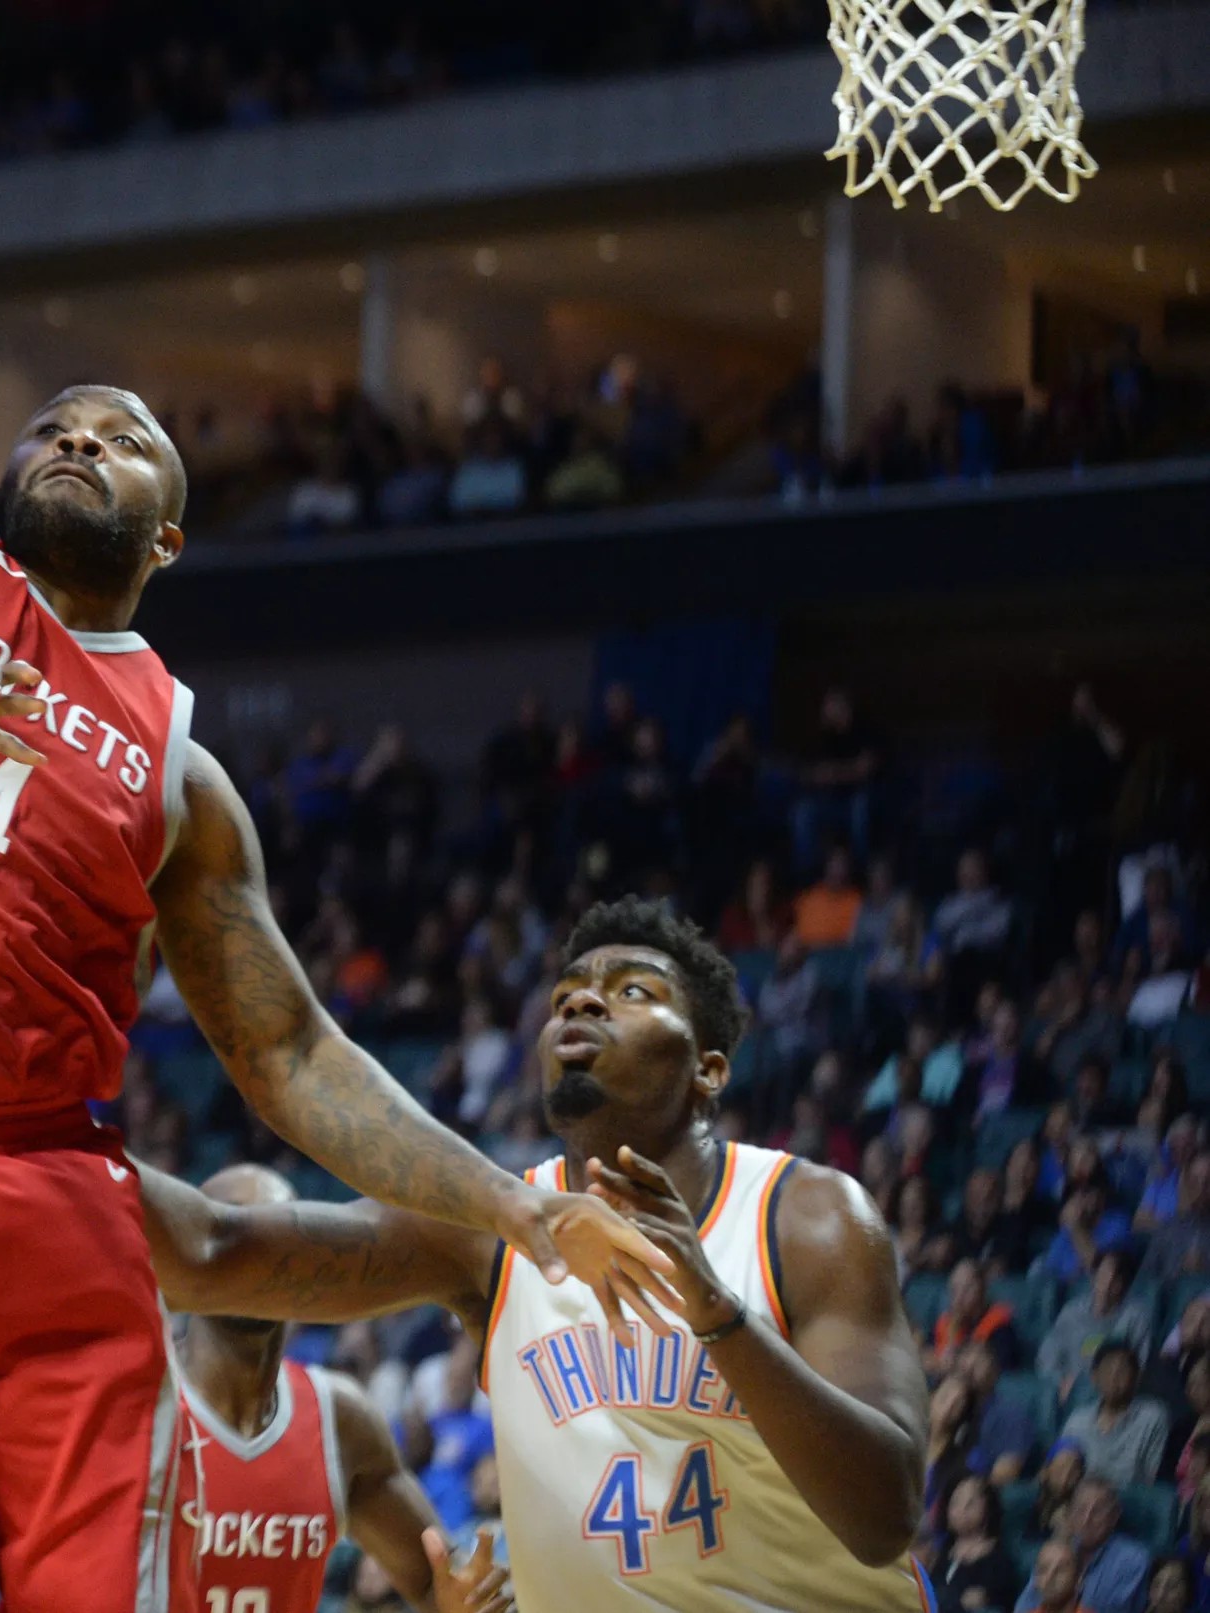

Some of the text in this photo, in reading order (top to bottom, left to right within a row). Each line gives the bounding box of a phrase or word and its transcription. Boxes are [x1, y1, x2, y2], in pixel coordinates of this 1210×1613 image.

[517, 1320, 751, 1429] THNDE
[199, 1510, 327, 1561] CKETS
[581, 1439, 730, 1577] 44
